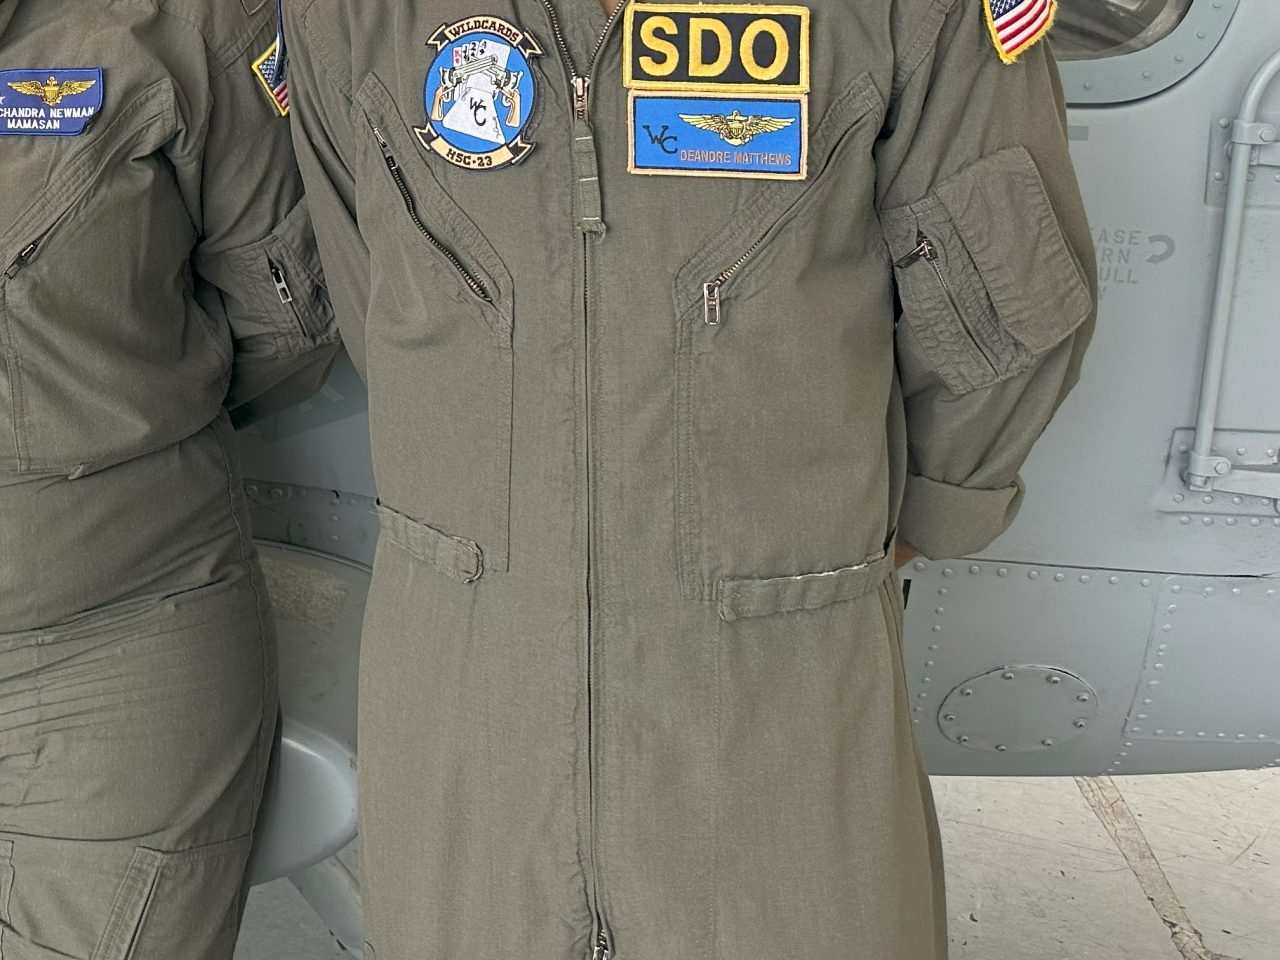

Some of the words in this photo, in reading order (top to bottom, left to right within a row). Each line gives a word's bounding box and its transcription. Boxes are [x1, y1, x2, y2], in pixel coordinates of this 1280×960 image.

[448, 19, 520, 42] WILDCARDS
[638, 16, 790, 81] SDO
[49, 106, 95, 118] NEWMAN
[7, 119, 61, 130] MAMASAN
[445, 148, 493, 167] HSC-23
[680, 149, 732, 163] DEANDRE
[734, 152, 793, 166] MATTHEWS
[1090, 226, 1142, 246] ASE
[1099, 267, 1139, 285] ULL
